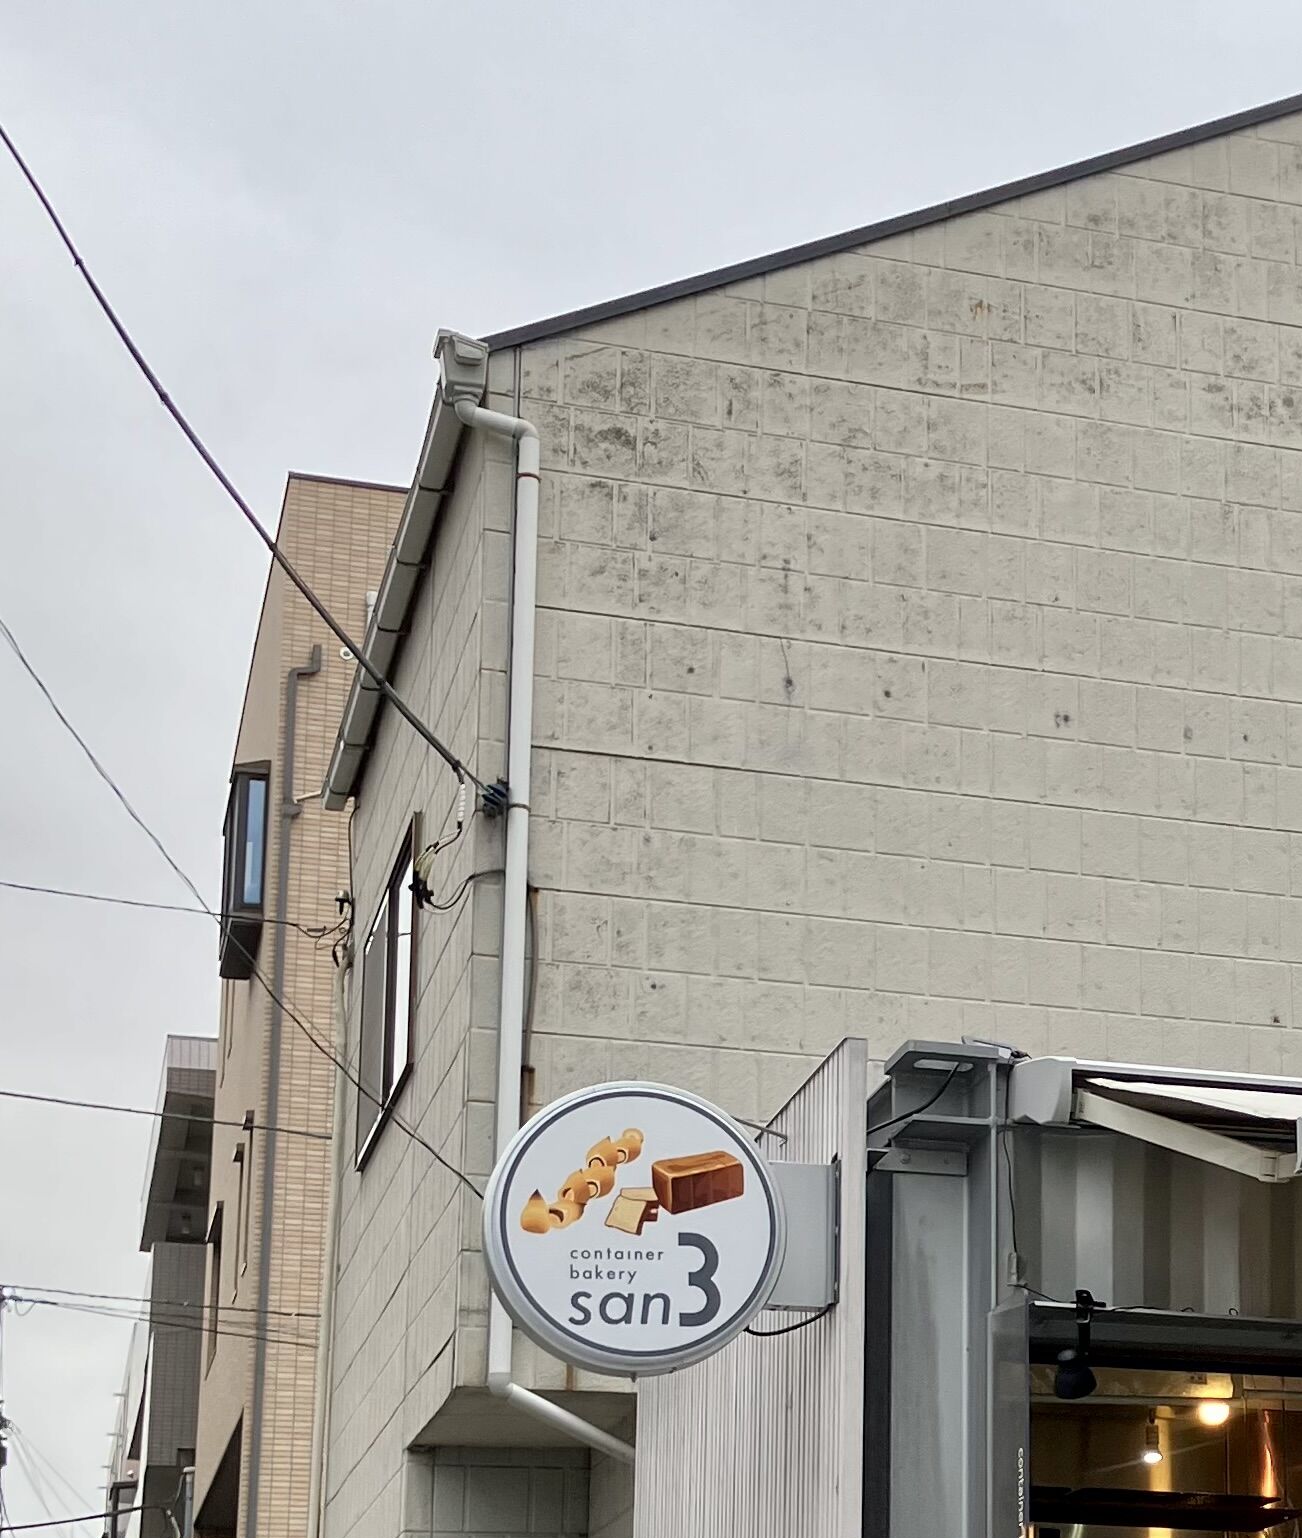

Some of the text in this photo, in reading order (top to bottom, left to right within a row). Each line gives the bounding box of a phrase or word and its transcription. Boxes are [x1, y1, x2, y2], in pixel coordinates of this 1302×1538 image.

[570, 1247, 664, 1261] container
[568, 1232, 721, 1327] san 3
[569, 1264, 637, 1284] bakery
